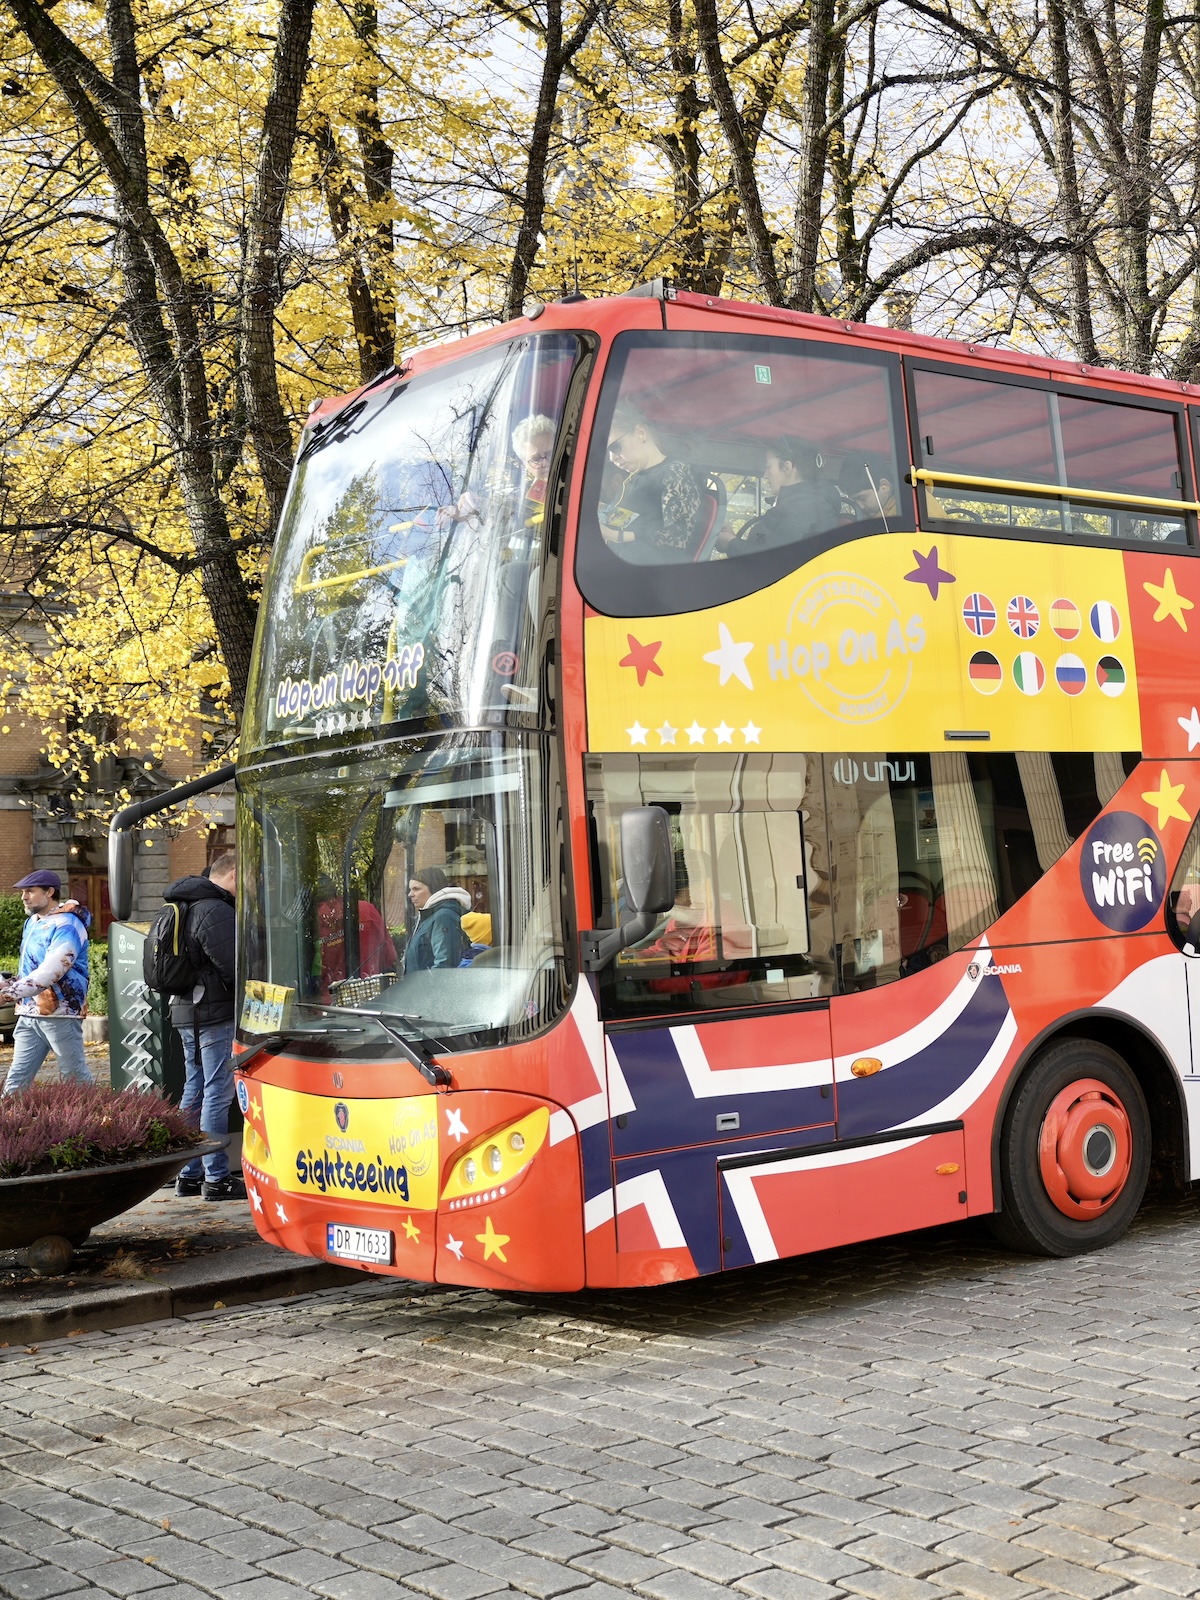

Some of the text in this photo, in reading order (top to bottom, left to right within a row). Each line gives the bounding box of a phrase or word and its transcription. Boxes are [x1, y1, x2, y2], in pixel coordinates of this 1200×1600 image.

[797, 581, 882, 625] SIGHTSEEING
[767, 613, 927, 682] Hop On AS
[275, 676, 313, 721] Hop
[340, 659, 382, 706] Hop
[382, 641, 425, 691] off
[838, 692, 889, 717] NORWAY
[1091, 840, 1135, 865] Free
[1091, 863, 1153, 907] WiFi
[982, 963, 1023, 976] SCANIA
[325, 1135, 367, 1154] SCANIA
[389, 1134, 407, 1156] Hop
[423, 1117, 437, 1142] AS
[296, 1149, 410, 1202] Sightseeing
[336, 1228, 388, 1256] DR 71633
